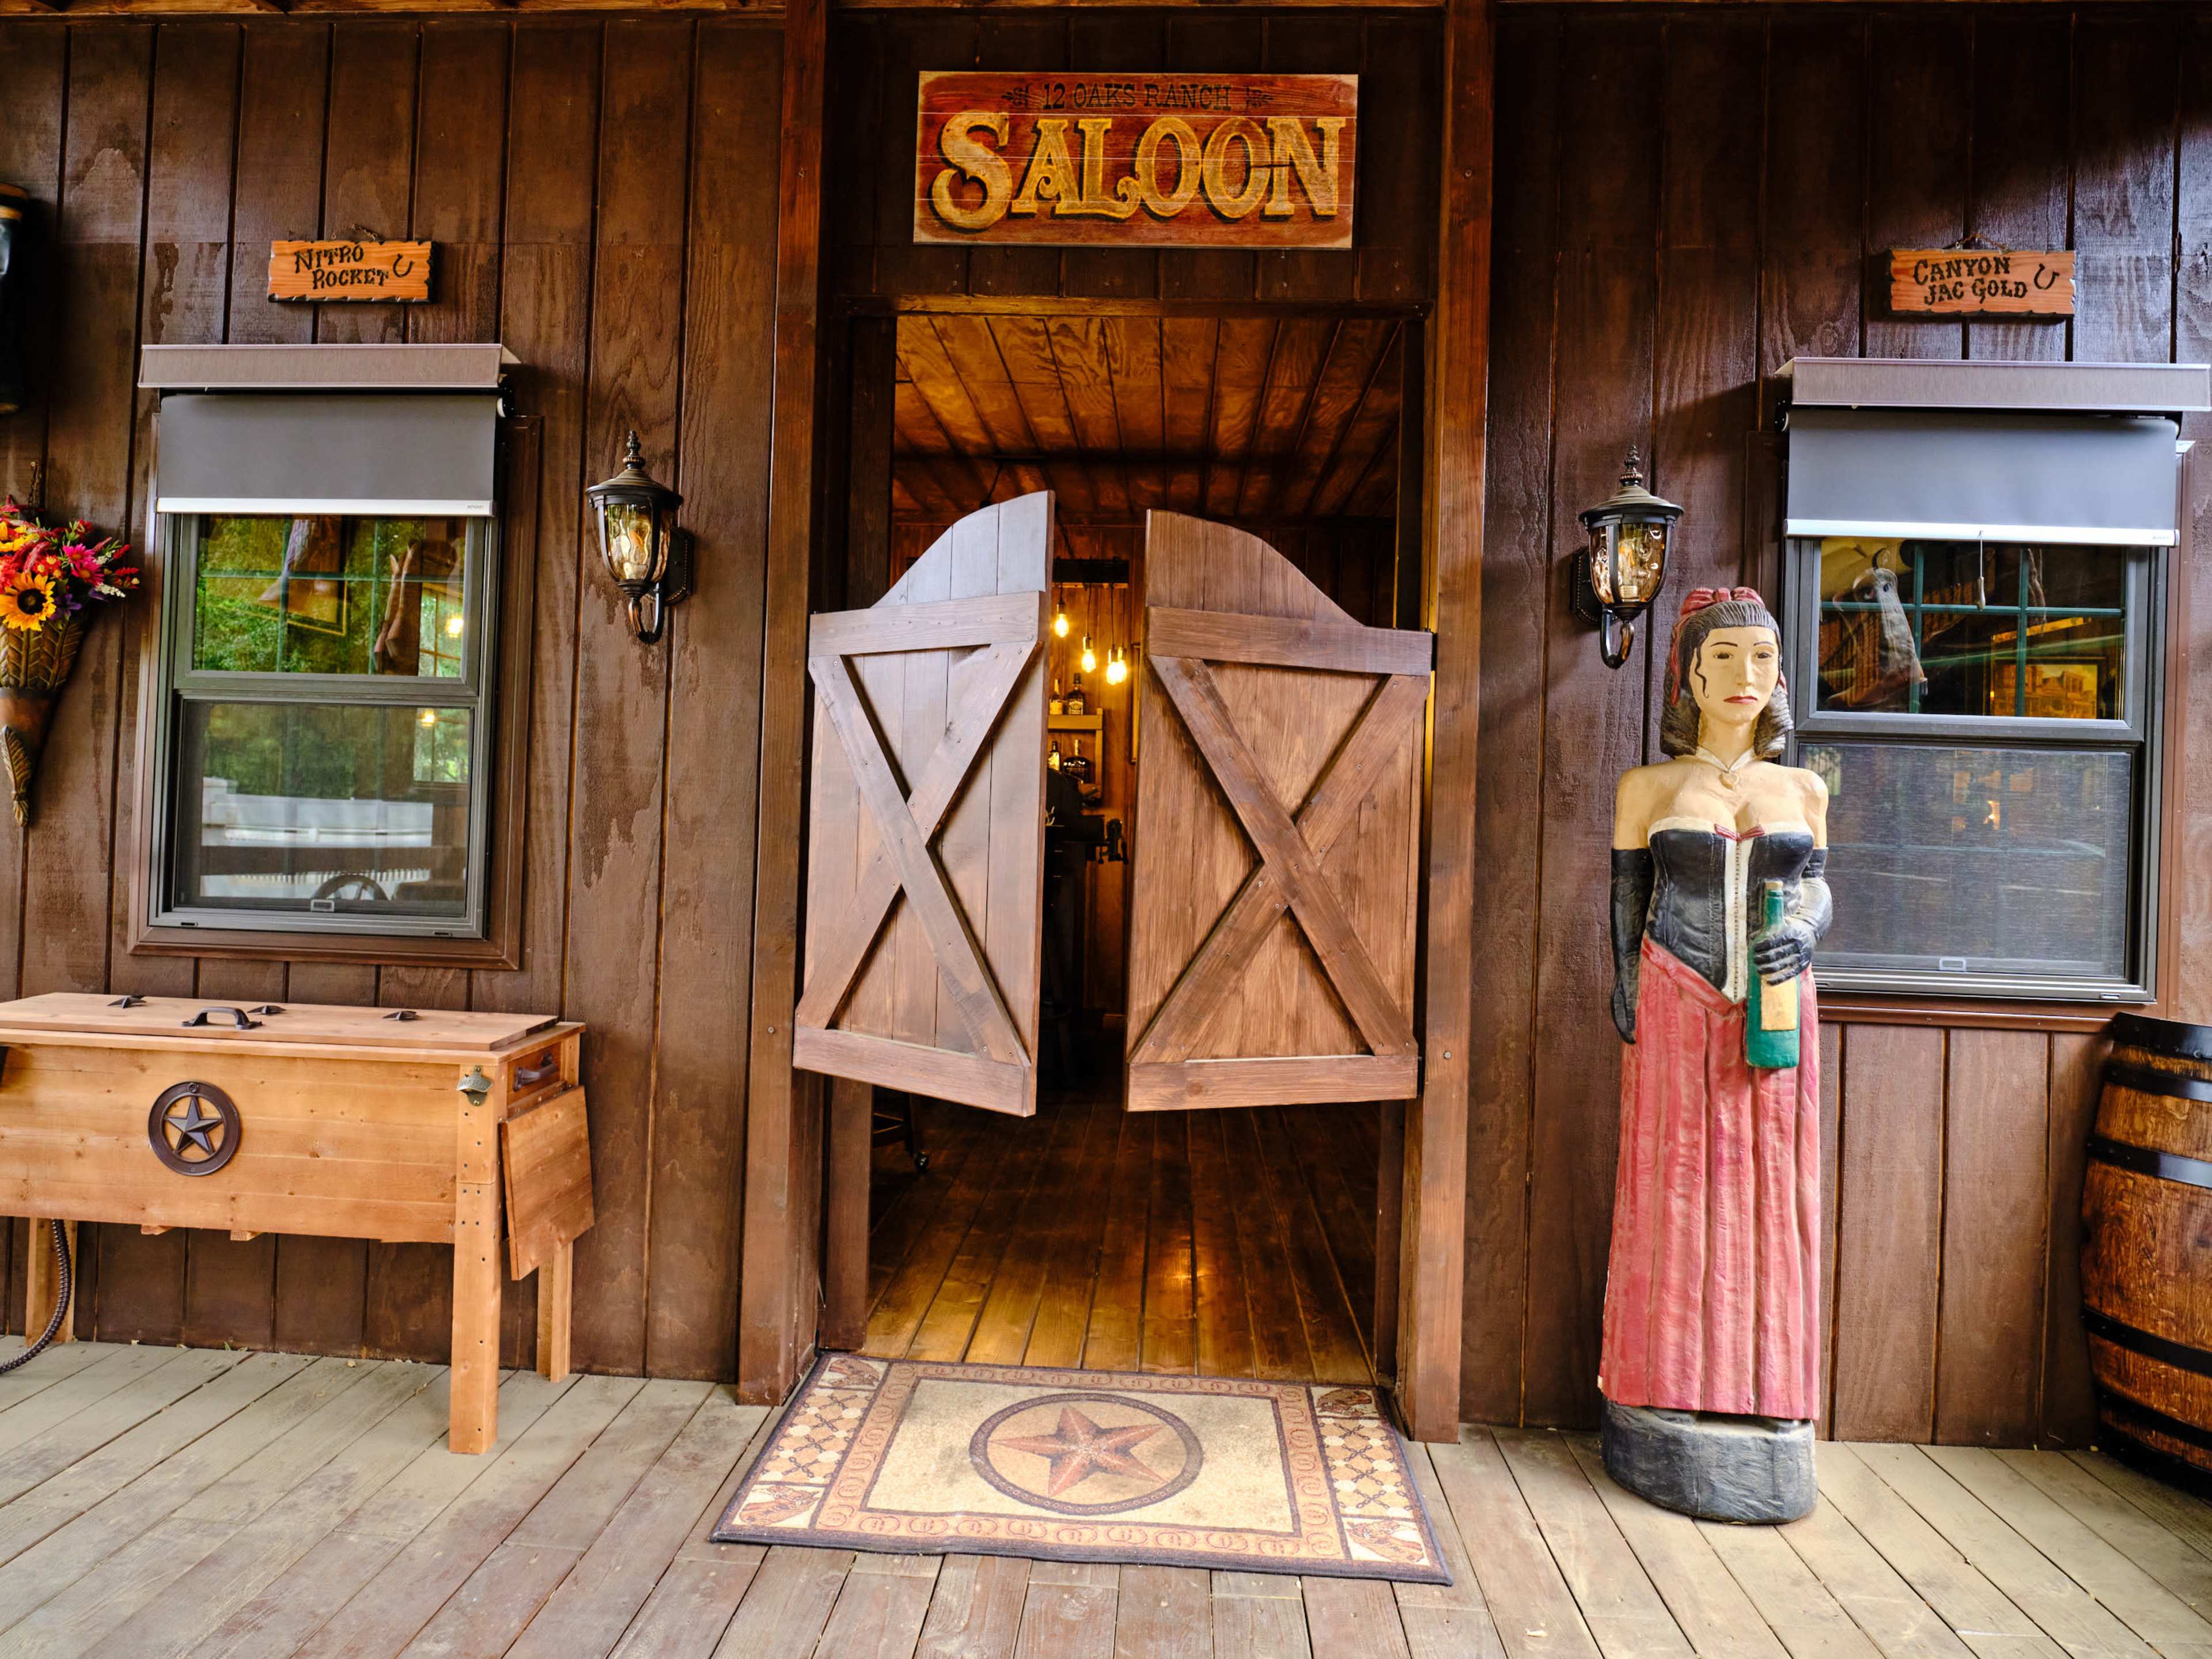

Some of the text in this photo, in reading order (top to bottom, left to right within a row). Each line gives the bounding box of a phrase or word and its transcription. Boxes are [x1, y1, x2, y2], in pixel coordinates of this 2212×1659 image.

[1043, 82, 1232, 111] 12 OAKS RANCH
[930, 111, 1346, 232] SALOON
[294, 244, 364, 274] NITRO
[1913, 256, 2010, 285] CANYON
[312, 268, 389, 289] ROCKET
[1971, 278, 2028, 304] GOLD
